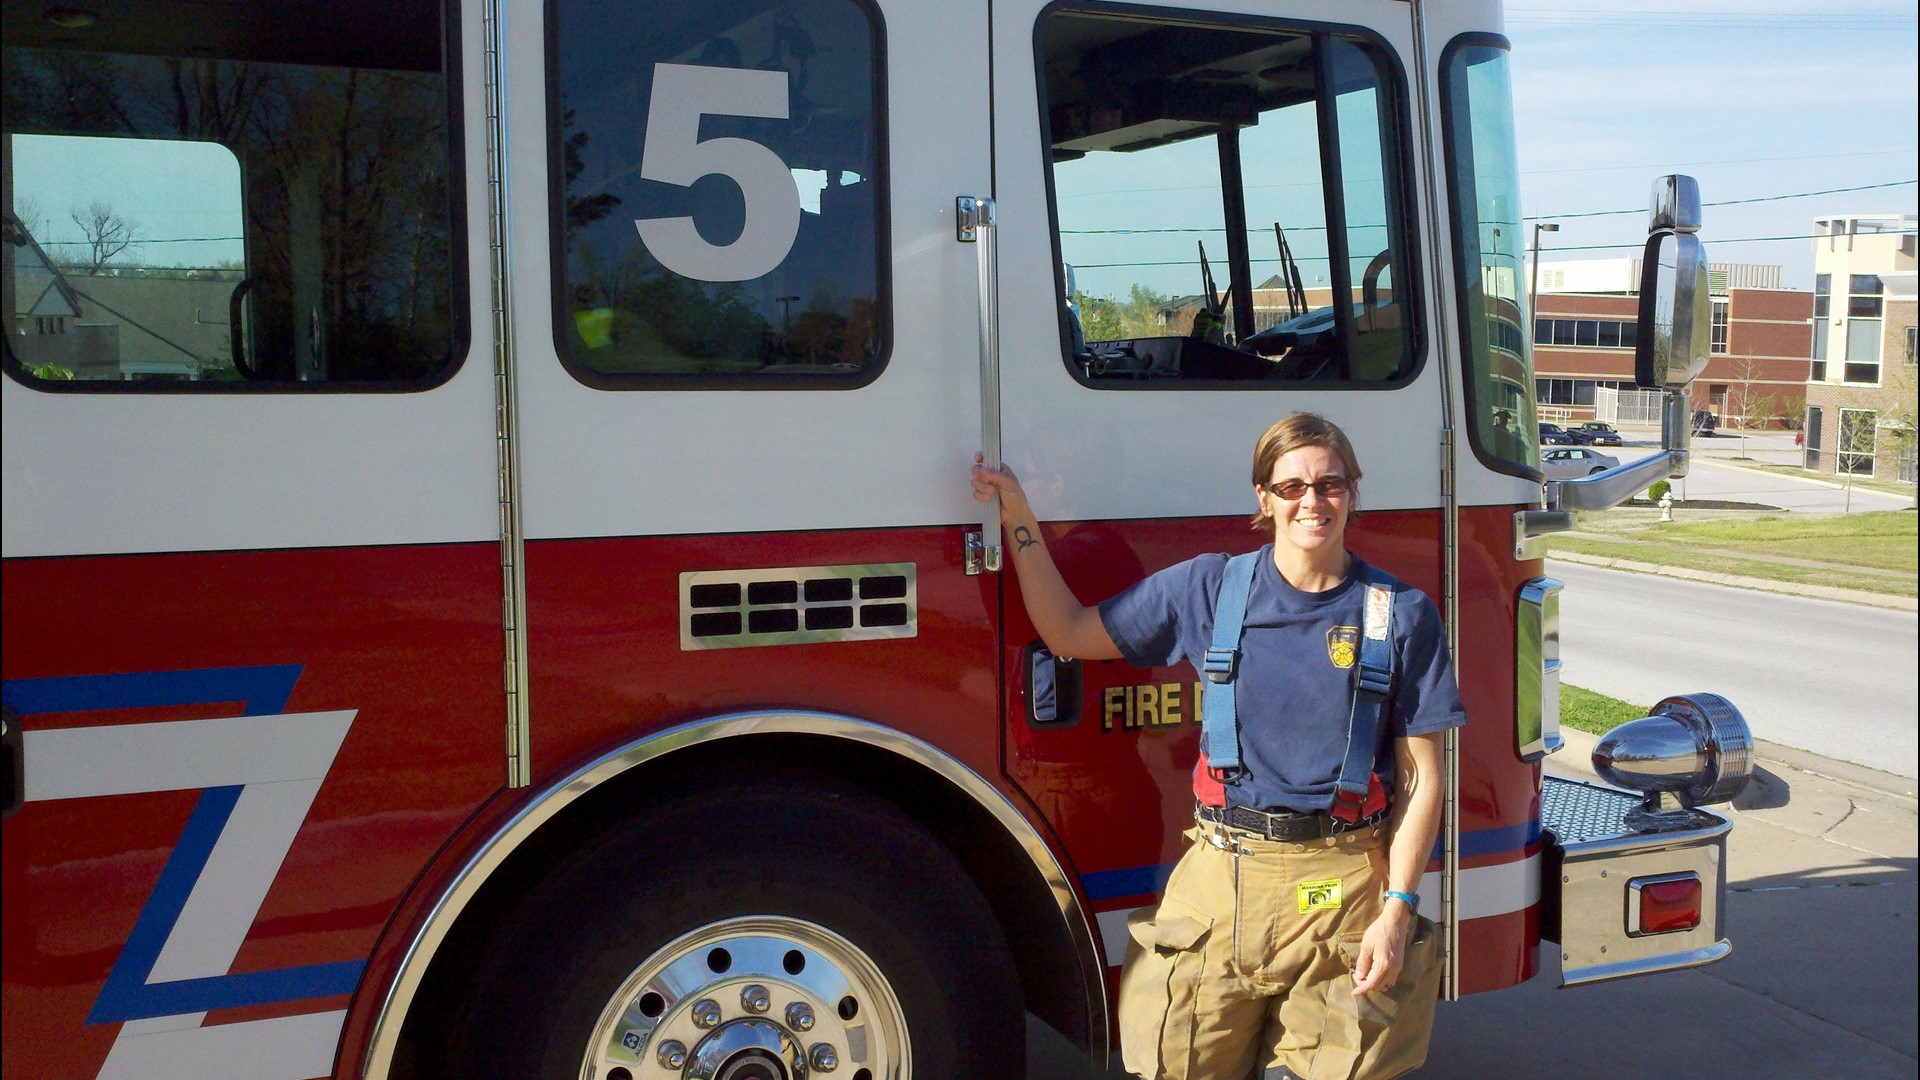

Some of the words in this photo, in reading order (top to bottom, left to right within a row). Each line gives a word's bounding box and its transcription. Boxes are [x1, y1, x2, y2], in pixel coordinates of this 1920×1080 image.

[634, 62, 801, 282] 5
[1105, 682, 1181, 729] FIRE
[635, 1033, 648, 1057] ALCOA
